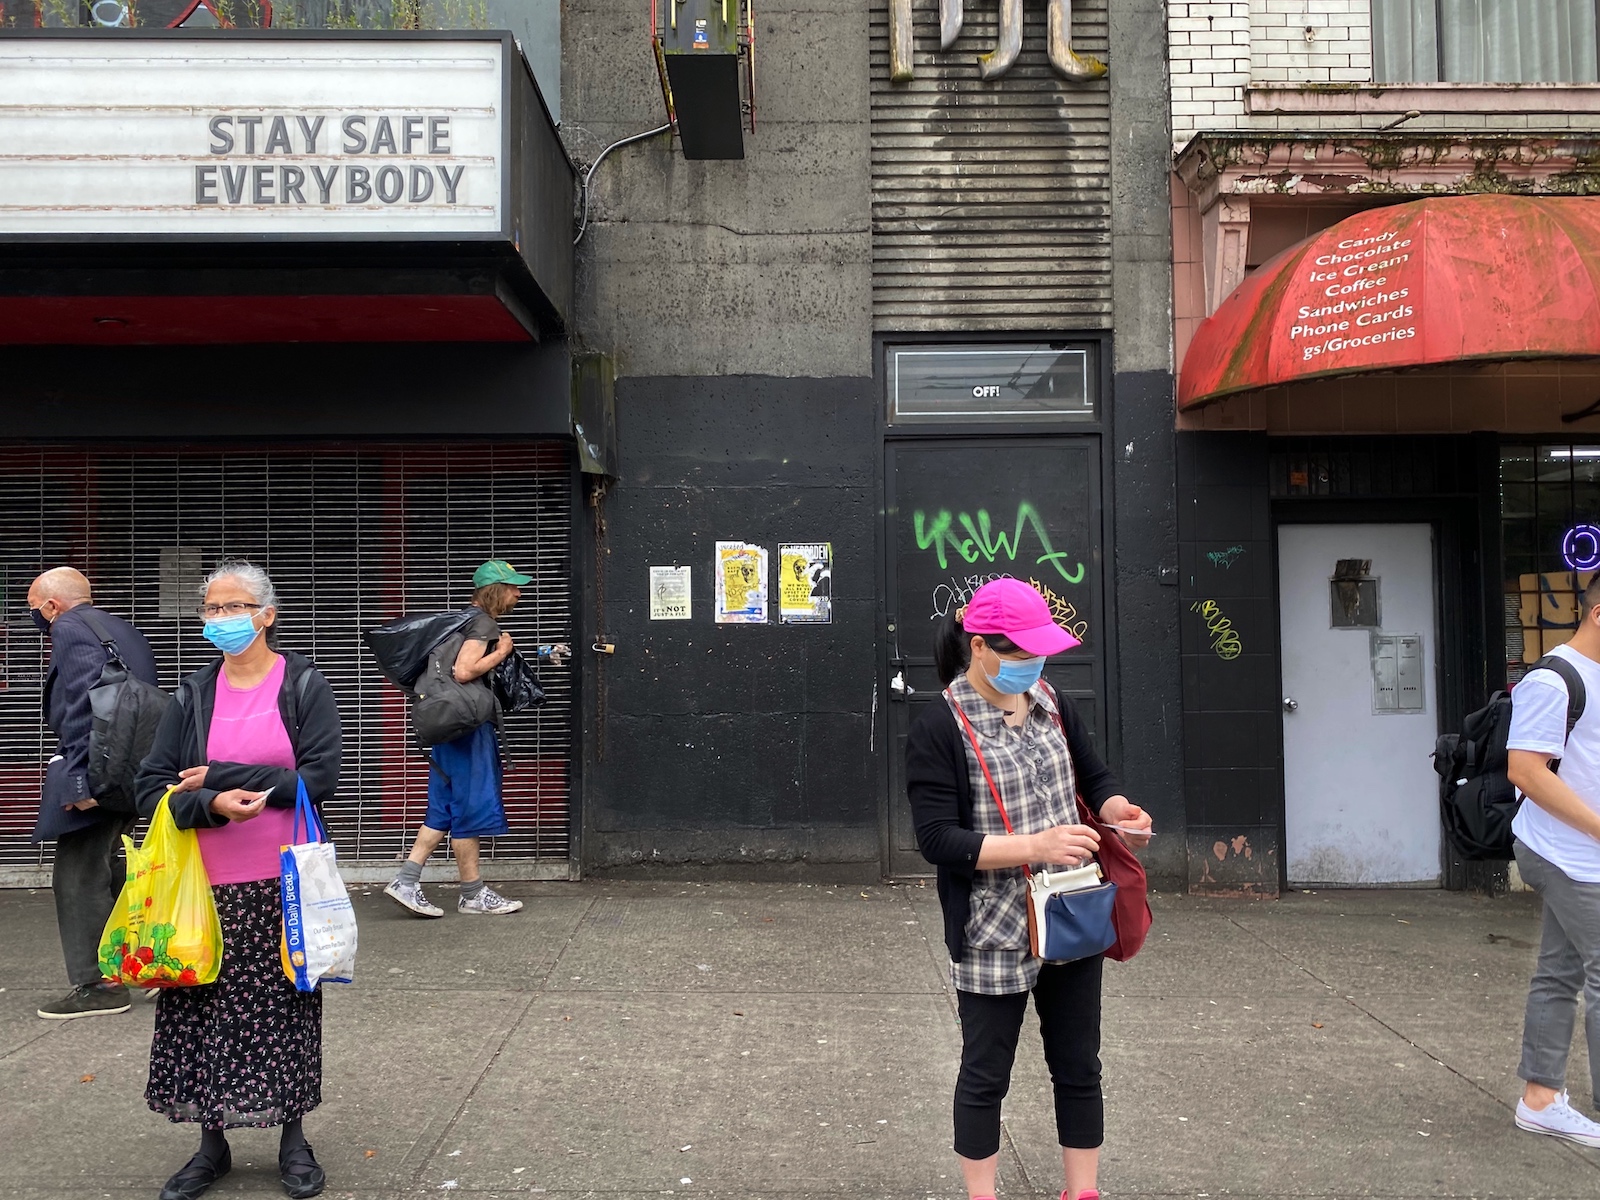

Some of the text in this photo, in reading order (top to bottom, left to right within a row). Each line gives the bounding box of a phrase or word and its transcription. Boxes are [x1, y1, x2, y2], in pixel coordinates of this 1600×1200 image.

[209, 116, 452, 155] STAY SAFE
[195, 165, 466, 204] EVERYBODY
[1315, 238, 1412, 266] Chocolate
[1338, 230, 1399, 249] Candy
[1309, 252, 1410, 283] Ice Cream
[1325, 275, 1387, 297] Coffee
[1298, 287, 1409, 319] Sandwiches
[1289, 304, 1413, 340] Phone Cards
[972, 386, 1000, 398] OFF!
[287, 903, 299, 925] Daily
[290, 928, 300, 946] Our
[313, 923, 344, 935] Our Daily Bread
